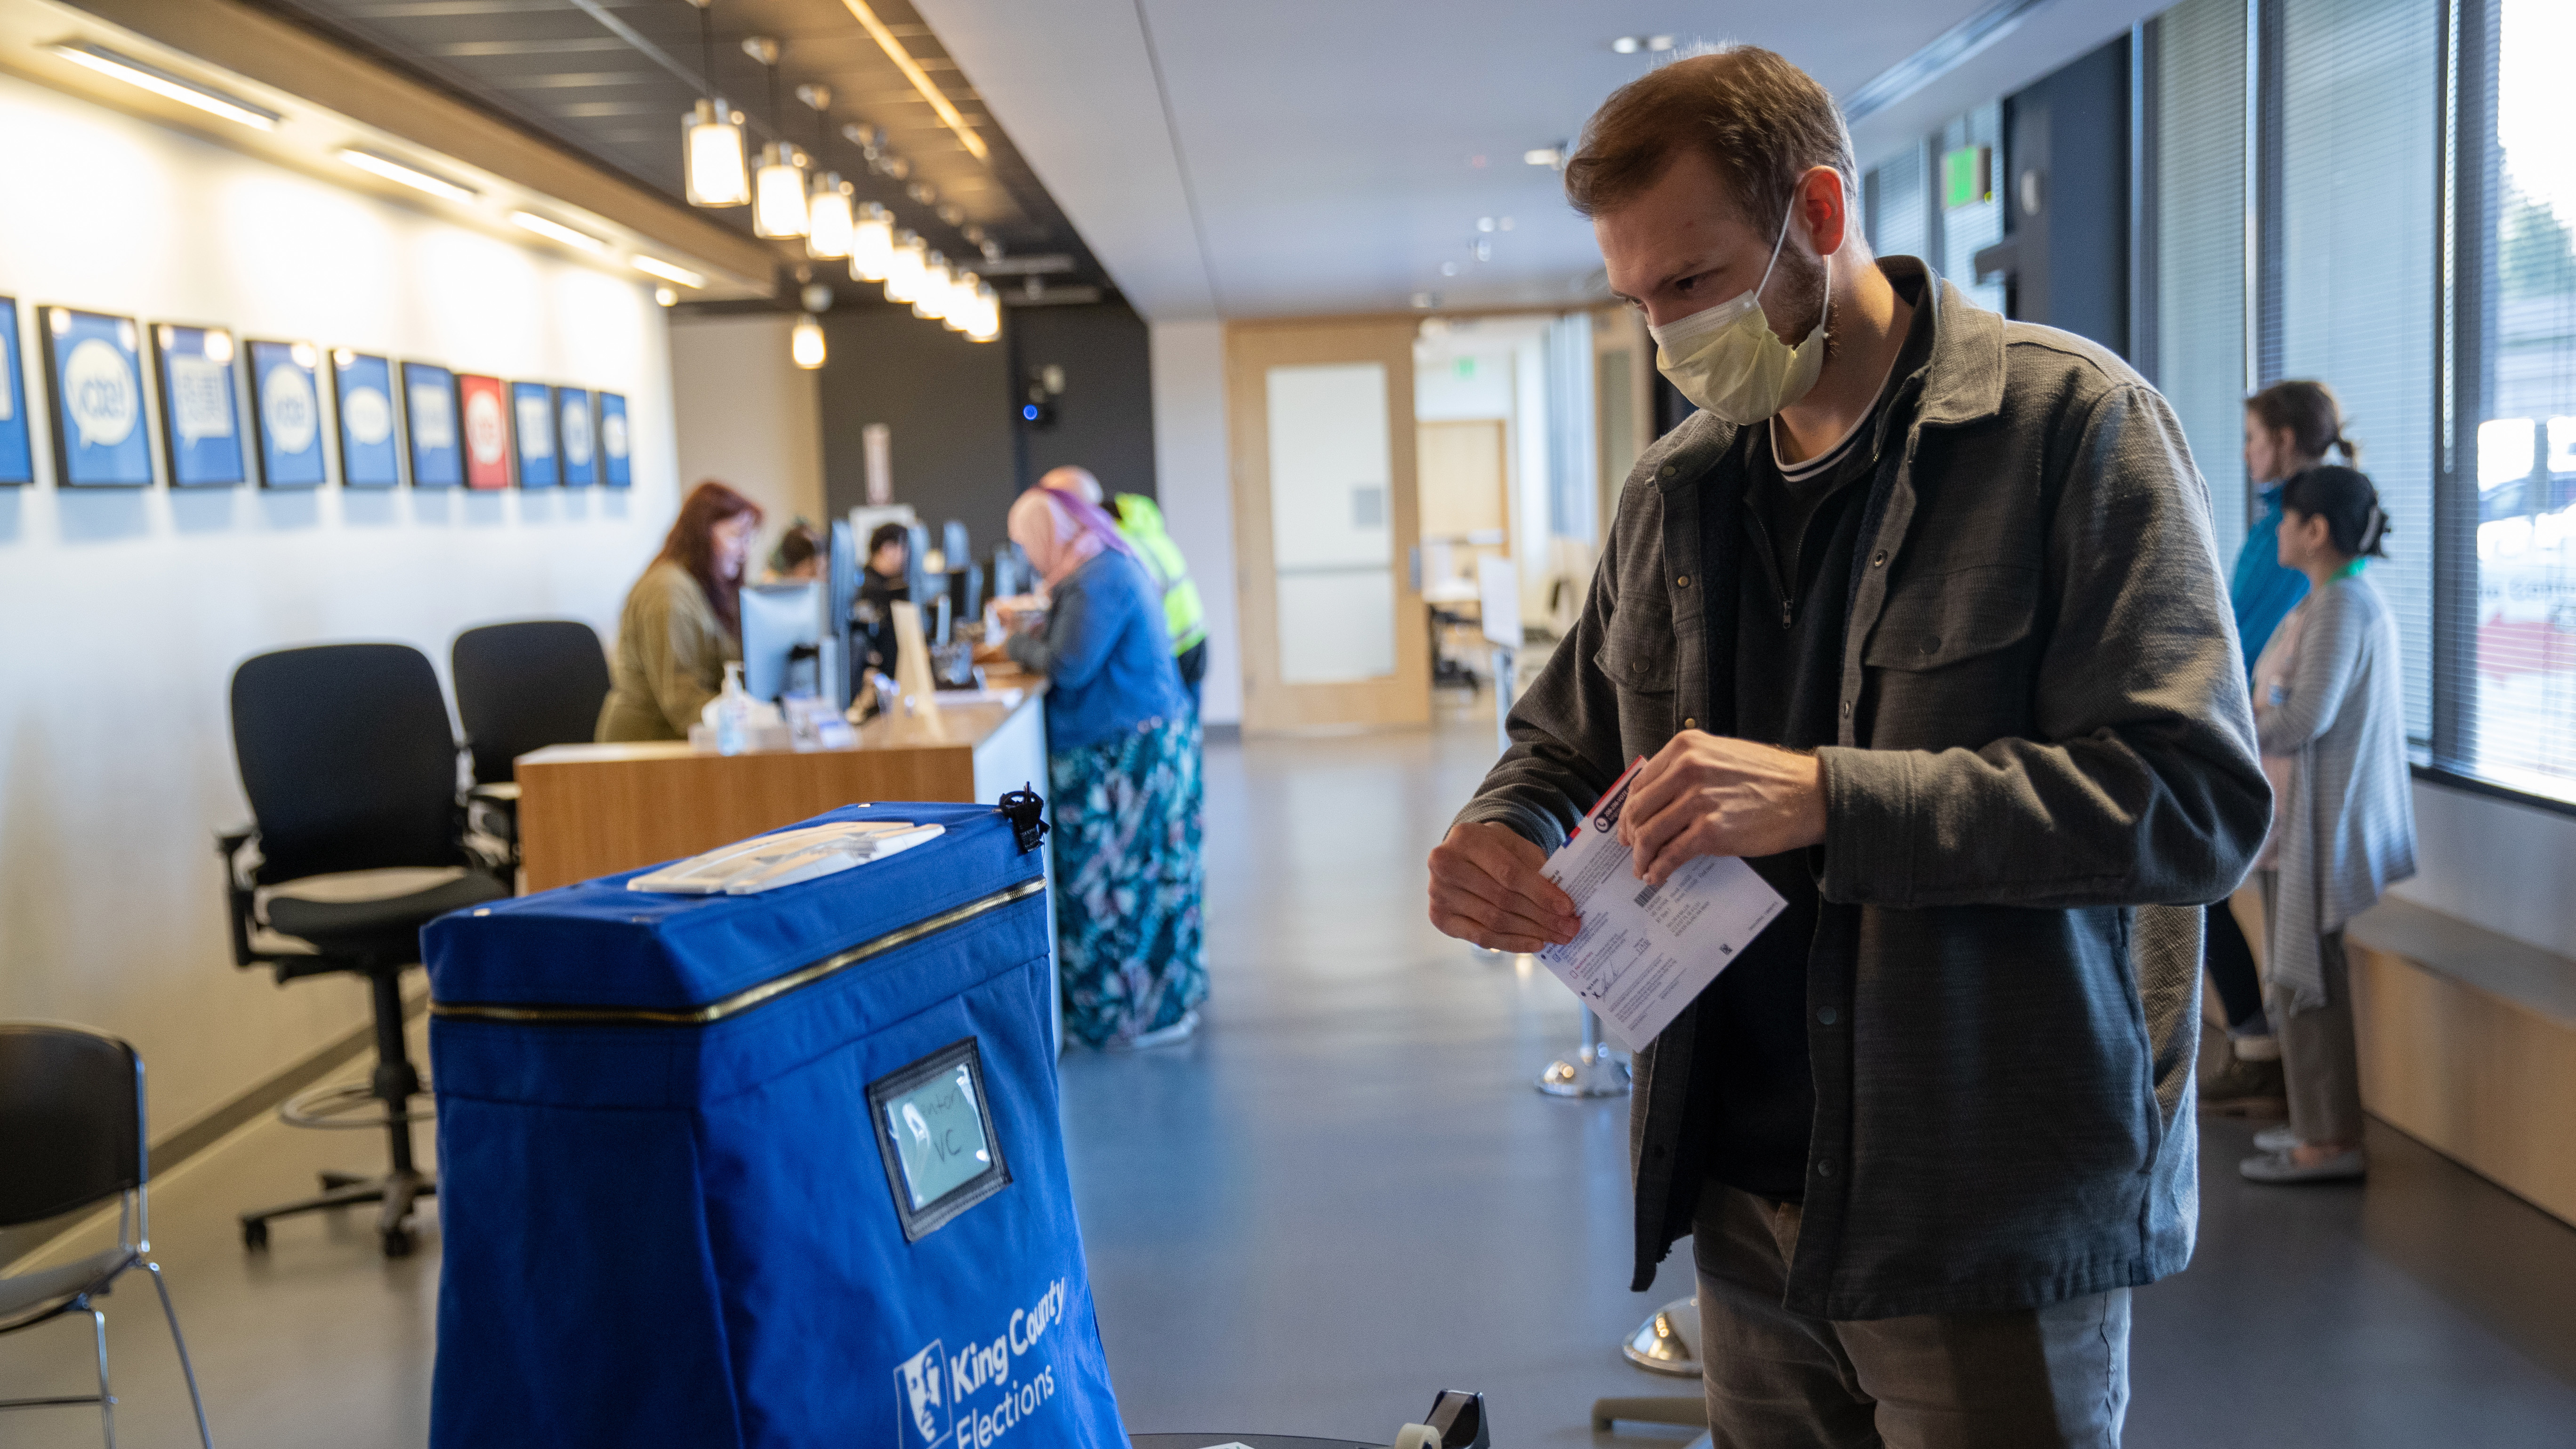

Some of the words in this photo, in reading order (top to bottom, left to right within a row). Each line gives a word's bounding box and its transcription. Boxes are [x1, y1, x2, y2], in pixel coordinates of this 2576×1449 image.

[934, 1128, 962, 1163] VC
[950, 1334, 1009, 1404] King
[1009, 1277, 1065, 1356] County
[957, 1365, 1055, 1449] Elections
